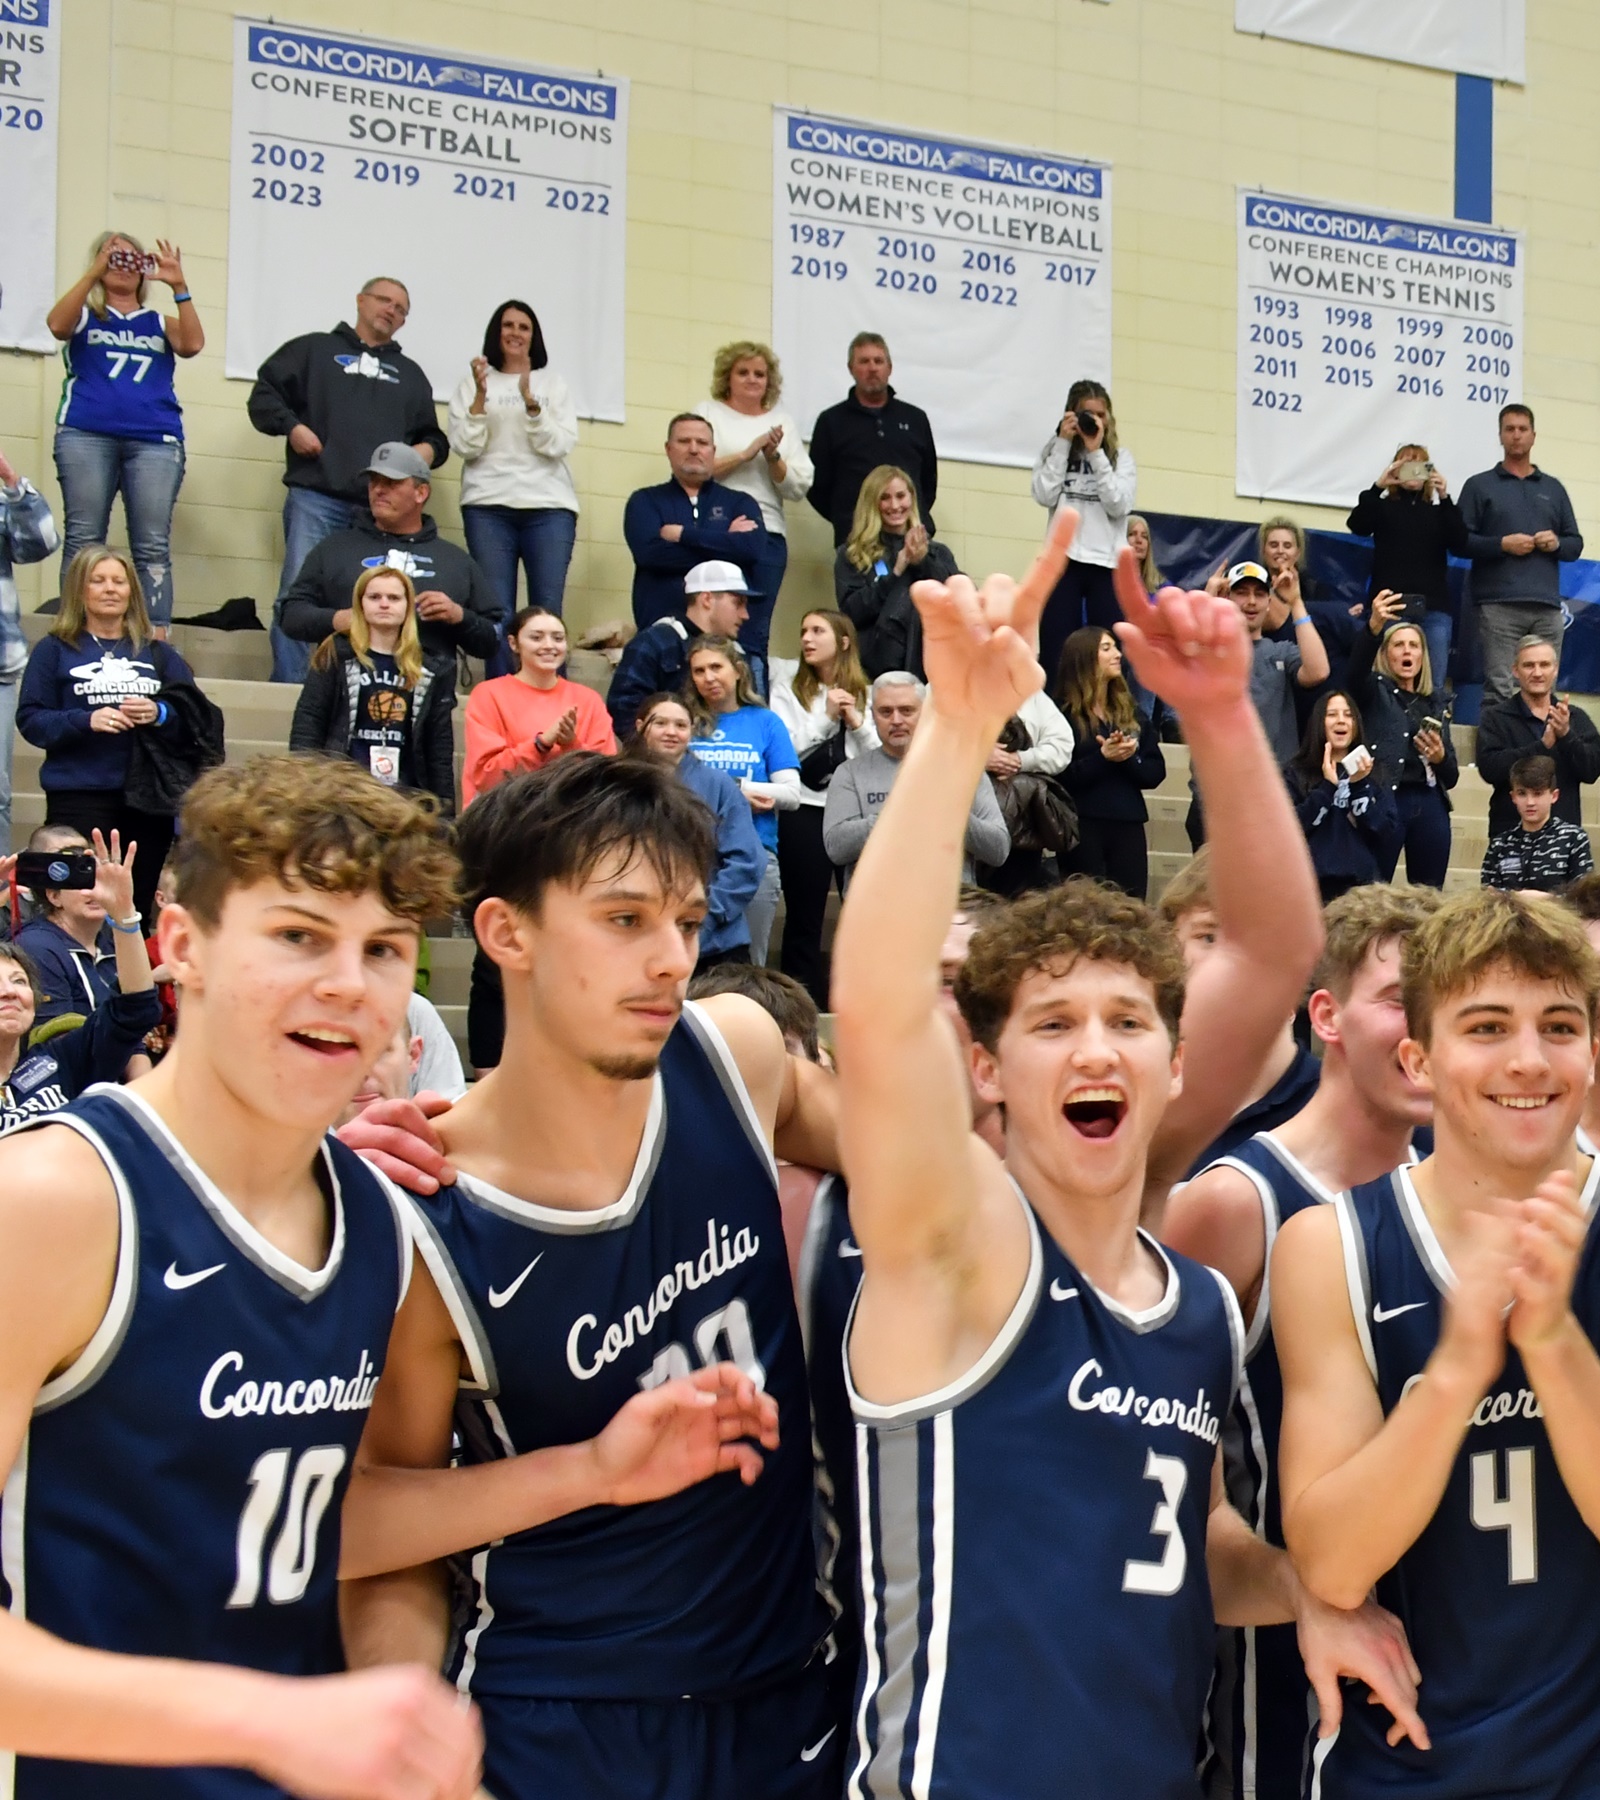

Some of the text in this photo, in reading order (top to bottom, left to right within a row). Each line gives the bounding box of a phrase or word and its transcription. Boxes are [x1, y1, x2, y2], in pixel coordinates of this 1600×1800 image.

[258, 36, 608, 113] CONCORDIA FALCONS
[0, 105, 43, 131] 20
[251, 72, 612, 145] CONFERENCE CHAMPIONS
[349, 114, 520, 163] SOFTBALL
[795, 124, 1095, 194] CONCORDIA FALCONS
[251, 143, 610, 216] 2002 2019 2021 2022
[252, 177, 322, 207] 2023
[790, 158, 1099, 222] CONFERENCE CHAMPIONS
[786, 182, 1103, 252] WOMEN'S VOLLEYBALL
[1251, 203, 1509, 263] CONCORDIA FALCONS
[790, 224, 1097, 286] 1987 2010 2016 2017
[790, 256, 1018, 307] 2019 2020 2022
[1248, 234, 1513, 289] CONFERENCE CHAMPIONS
[1268, 261, 1496, 313] WOMEN'S TENNIS
[1249, 324, 1510, 377] 2005 2006 2007 2010
[1253, 295, 1513, 349] 1993 1998 1999 2000
[106, 351, 152, 384] 77
[1253, 355, 1509, 405] 2011 2015 2016 2017
[1251, 388, 1302, 413] 2022
[693, 749, 761, 763] NCORDIA
[566, 1218, 760, 1382] Conordia
[225, 1444, 347, 1609] 10
[1121, 1447, 1188, 1597] 3
[1469, 1445, 1539, 1585] 4
